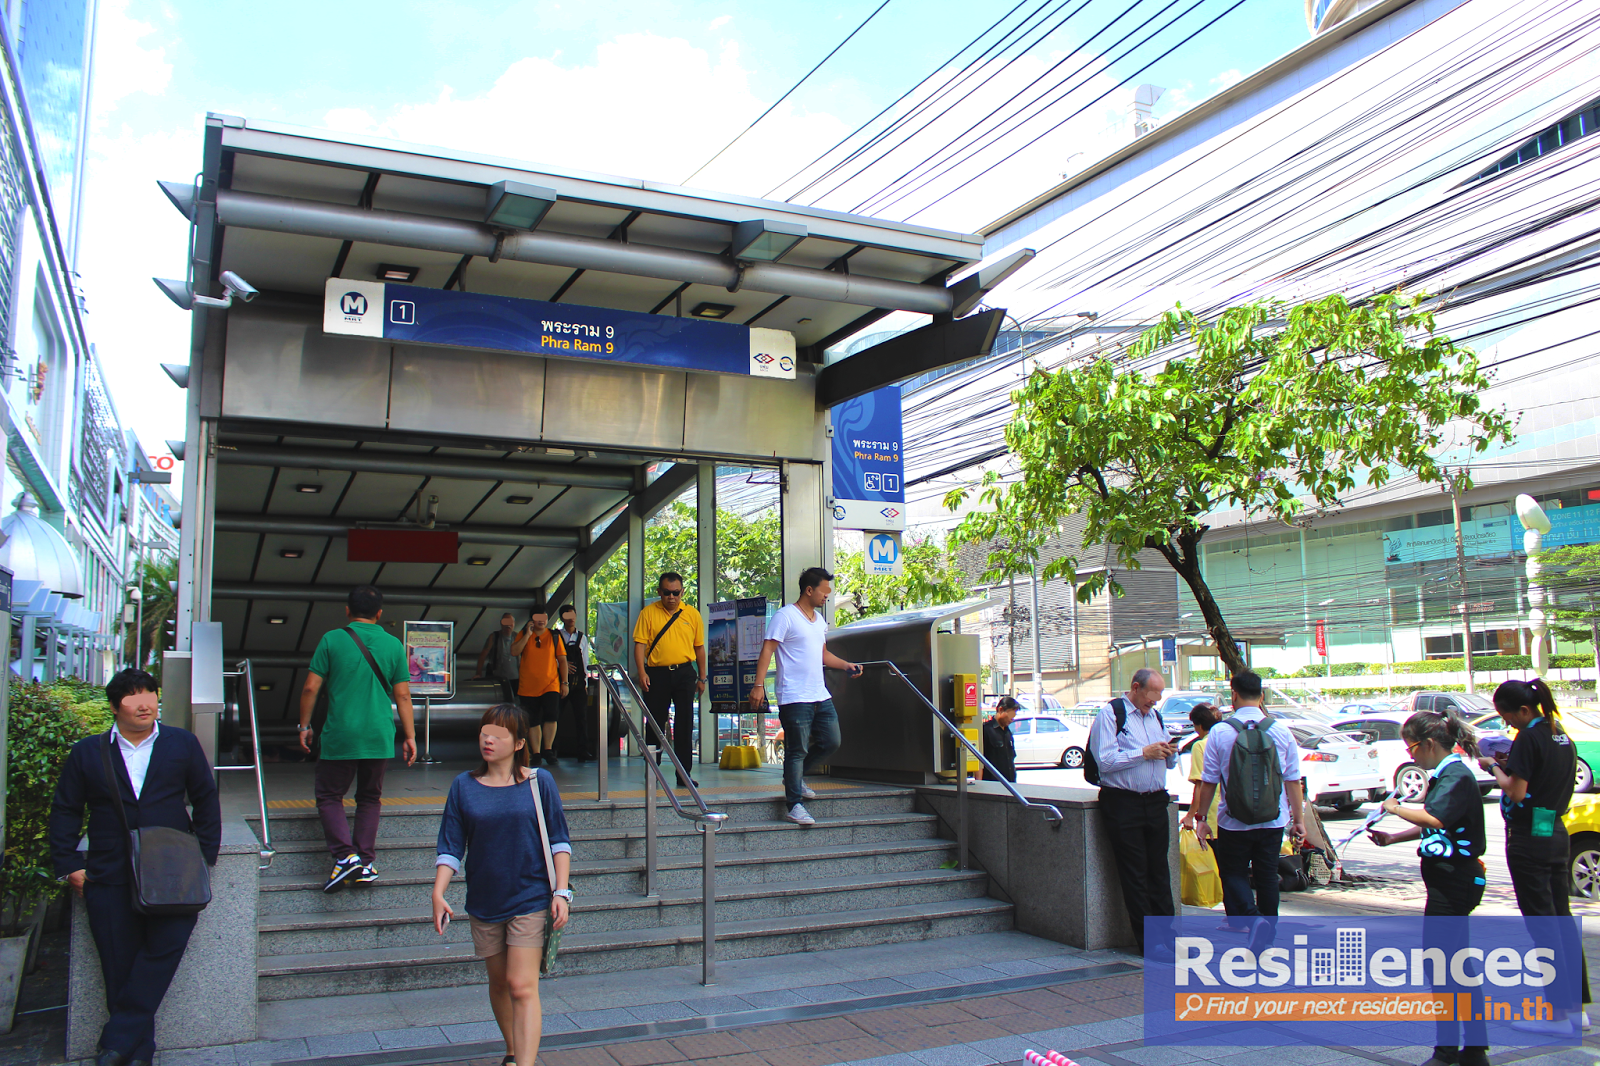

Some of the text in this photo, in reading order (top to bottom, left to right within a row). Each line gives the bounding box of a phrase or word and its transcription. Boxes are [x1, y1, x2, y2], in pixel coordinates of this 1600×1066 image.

[399, 304, 406, 319] 1
[541, 319, 615, 339] พระราม 9
[541, 335, 614, 354] Phra Ram 9
[853, 439, 899, 451] พระราม 9
[854, 451, 899, 462] Phra Ram 9
[888, 478, 893, 488] 1
[1552, 512, 1571, 521] ZONE
